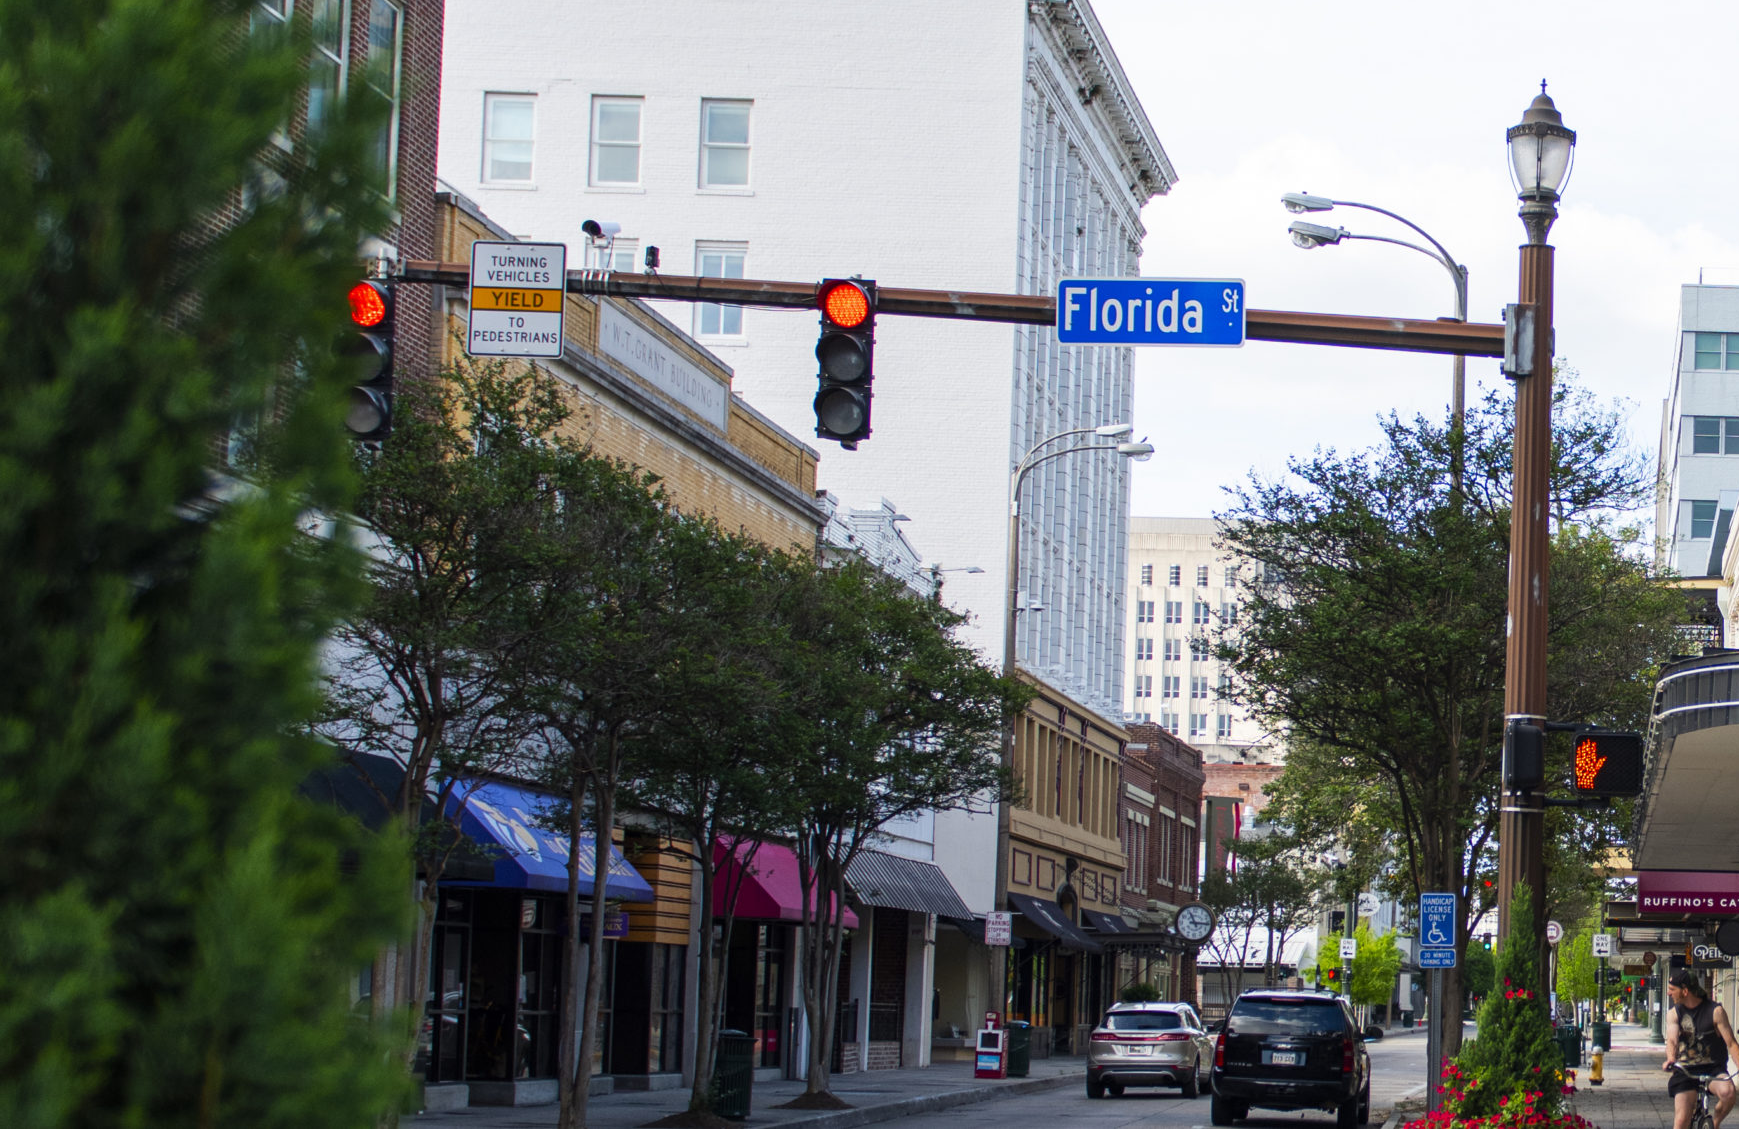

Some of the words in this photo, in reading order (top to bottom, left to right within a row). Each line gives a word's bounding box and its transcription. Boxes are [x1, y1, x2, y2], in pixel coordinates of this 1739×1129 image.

[491, 255, 548, 268] TURNING
[488, 271, 550, 283] VEHICLES
[491, 291, 544, 308] YIELD
[1064, 287, 1203, 333] Florida
[508, 317, 525, 328] TO
[473, 330, 558, 344] PEDESTRIANS
[670, 364, 712, 408] BUILDING
[1644, 897, 1714, 907] RUFFINO'S
